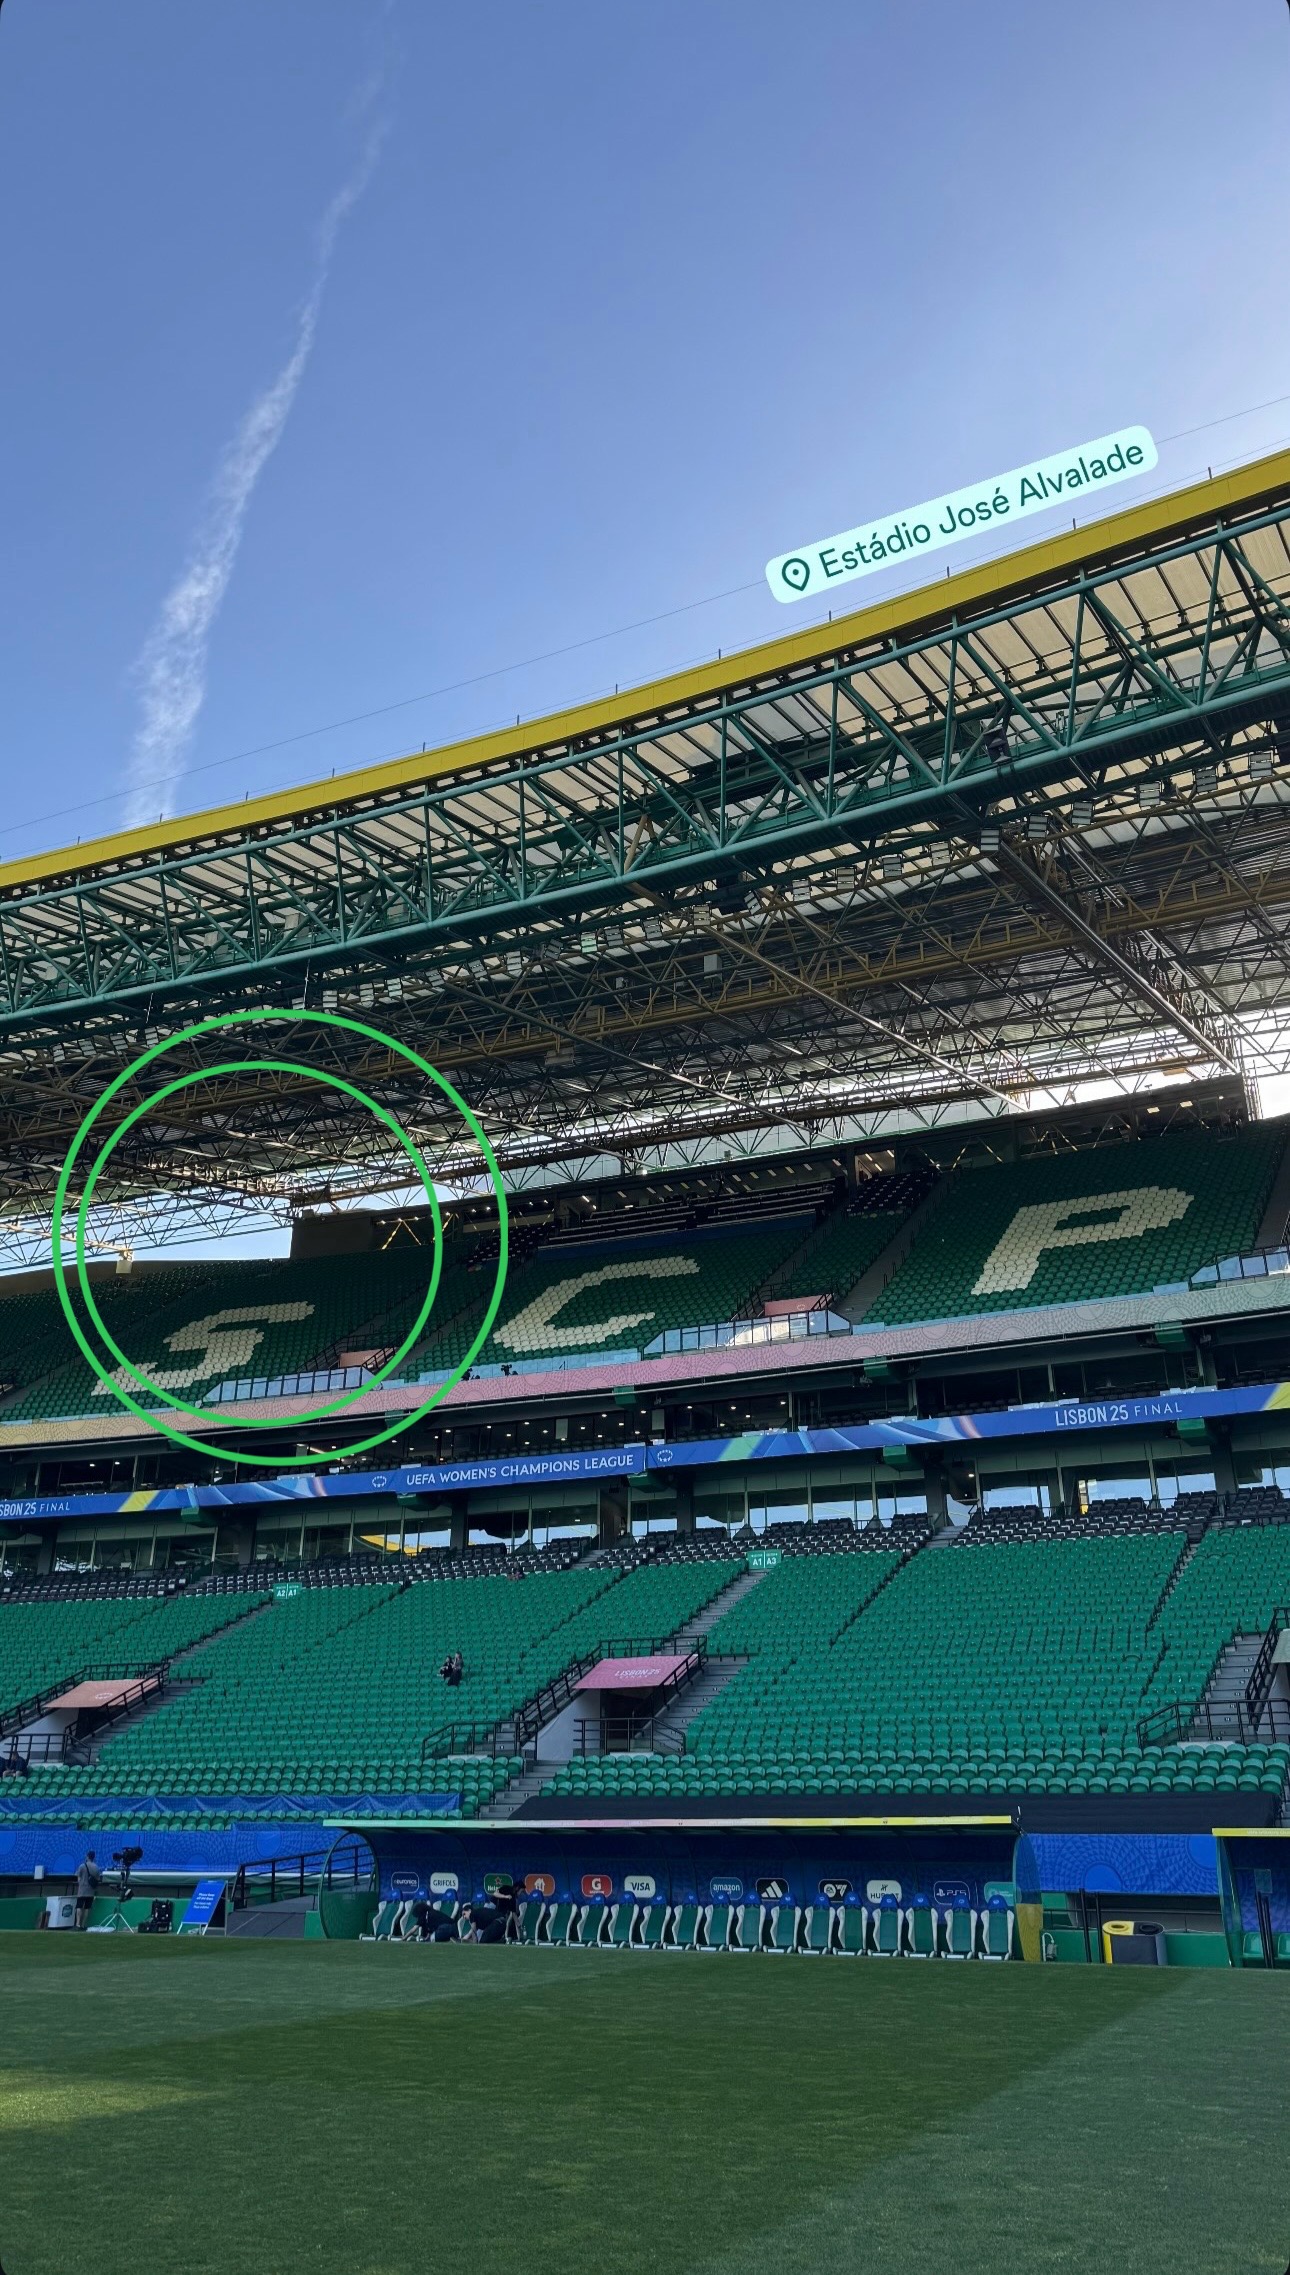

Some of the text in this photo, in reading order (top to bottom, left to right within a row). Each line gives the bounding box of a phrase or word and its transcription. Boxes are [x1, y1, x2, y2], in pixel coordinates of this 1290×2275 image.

[971, 1185, 1195, 1296] P
[1055, 1402, 1183, 1427] LISBON 25 FINAL
[406, 1454, 634, 1486] UEFA WOMEN'S CHAMPIONS LEAGUE
[24, 1502, 36, 1515] 25
[39, 1501, 70, 1512] FINAL
[752, 1558, 762, 1566] A1
[276, 1589, 297, 1597] A2 A1
[432, 1879, 456, 1888] GRIFOLS
[631, 1882, 651, 1891] VISA
[713, 1883, 741, 1892] amazon
